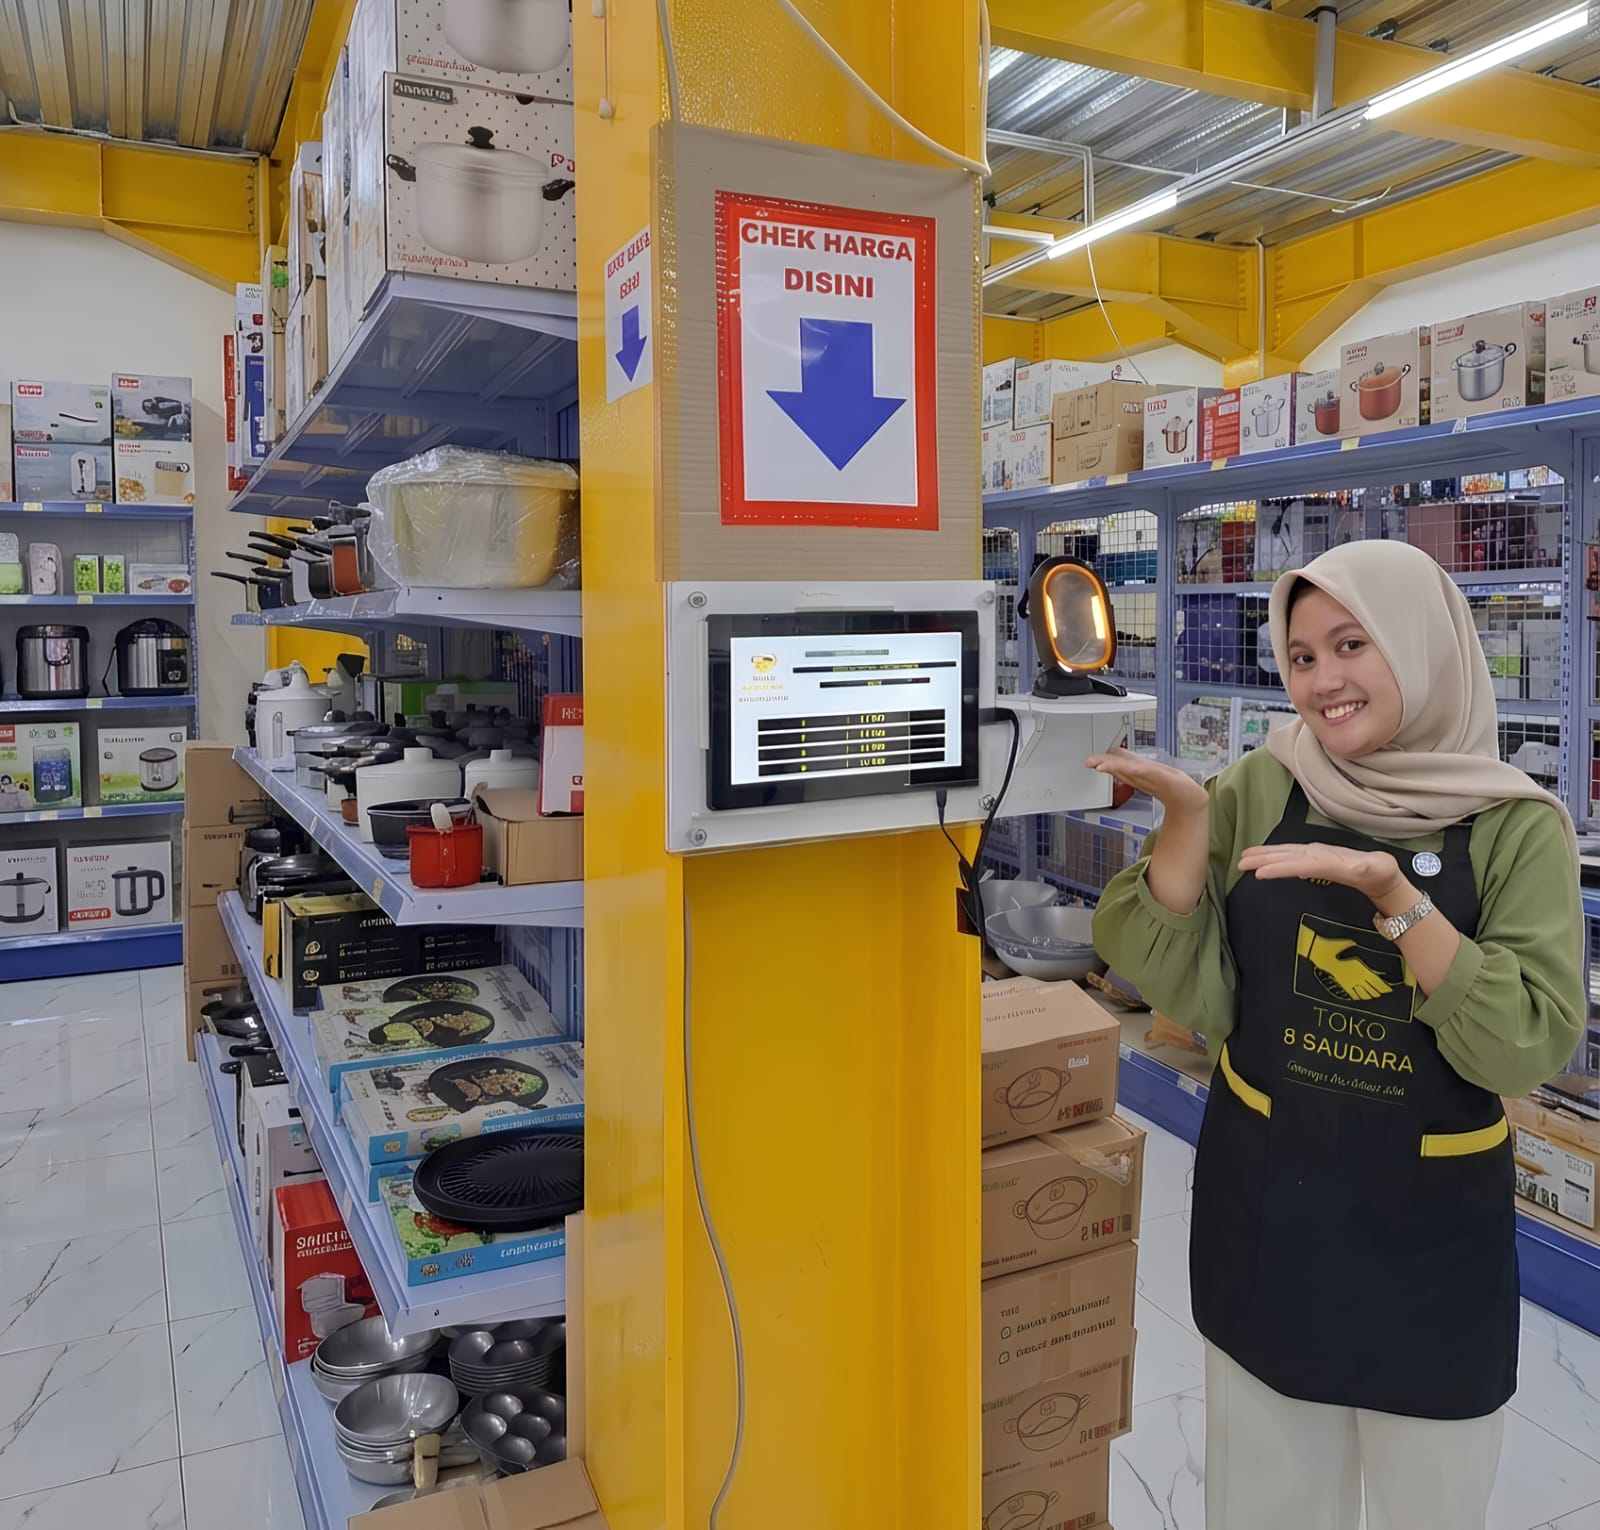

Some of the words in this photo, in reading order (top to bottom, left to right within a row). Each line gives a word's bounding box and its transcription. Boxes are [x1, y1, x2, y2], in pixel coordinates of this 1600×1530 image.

[741, 222, 816, 251] CHEK
[824, 232, 913, 261] HARGA
[784, 267, 875, 298] DISINI
[1313, 1006, 1386, 1042] TOKO
[1283, 1028, 1295, 1045] 8
[1302, 1032, 1414, 1074] SAUDARA
